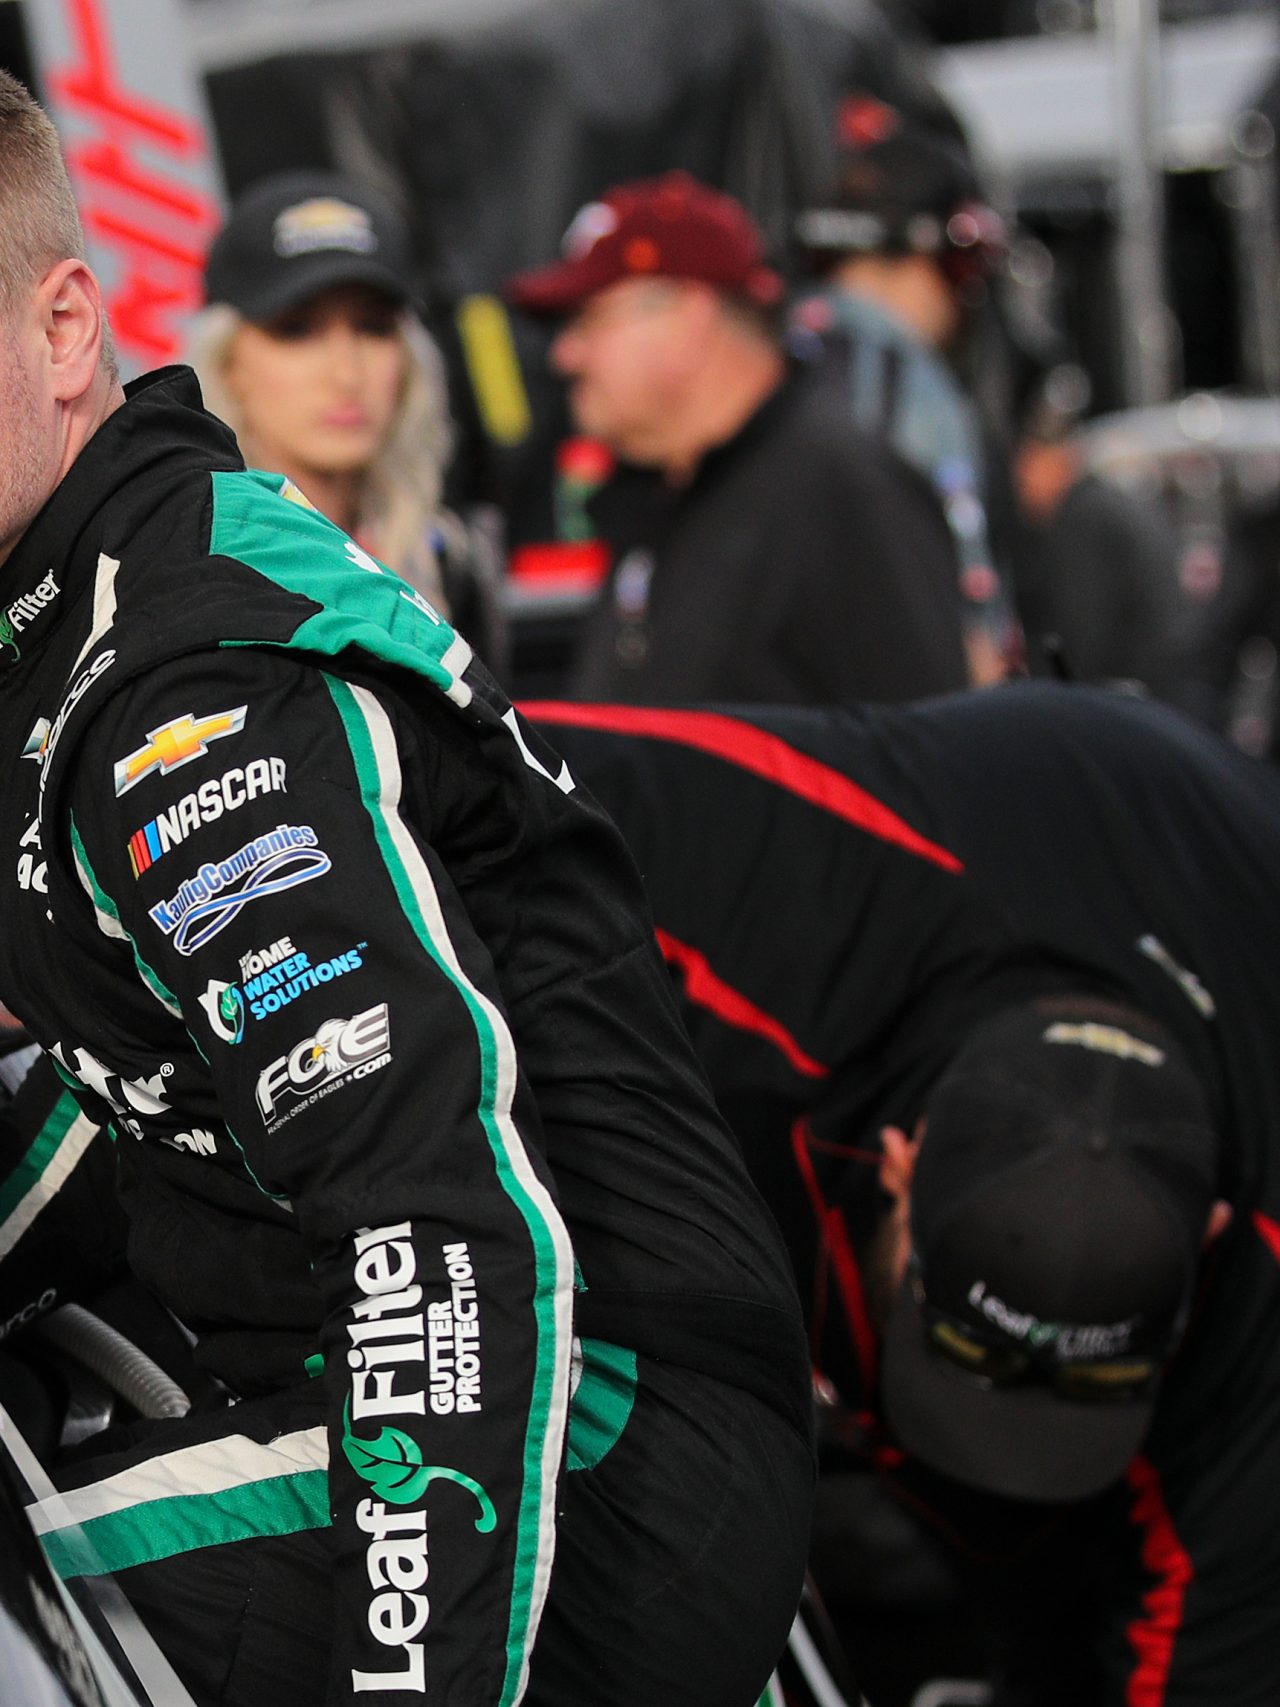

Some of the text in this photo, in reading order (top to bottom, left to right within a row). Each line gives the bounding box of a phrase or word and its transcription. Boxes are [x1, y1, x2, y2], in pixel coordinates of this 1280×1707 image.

[7, 572, 61, 632] Filter
[156, 757, 287, 853] NASCAR
[242, 936, 297, 983] HOME
[243, 952, 311, 1001] WATER
[250, 949, 363, 1021] SOLUTIONS
[290, 1100, 309, 1117] ORDER
[318, 1077, 345, 1099] EAGLES
[345, 1220, 428, 1421] Filter
[427, 1300, 455, 1415] GUTTER
[442, 1241, 482, 1414] PROTECTION
[351, 1498, 429, 1694] Leaf
